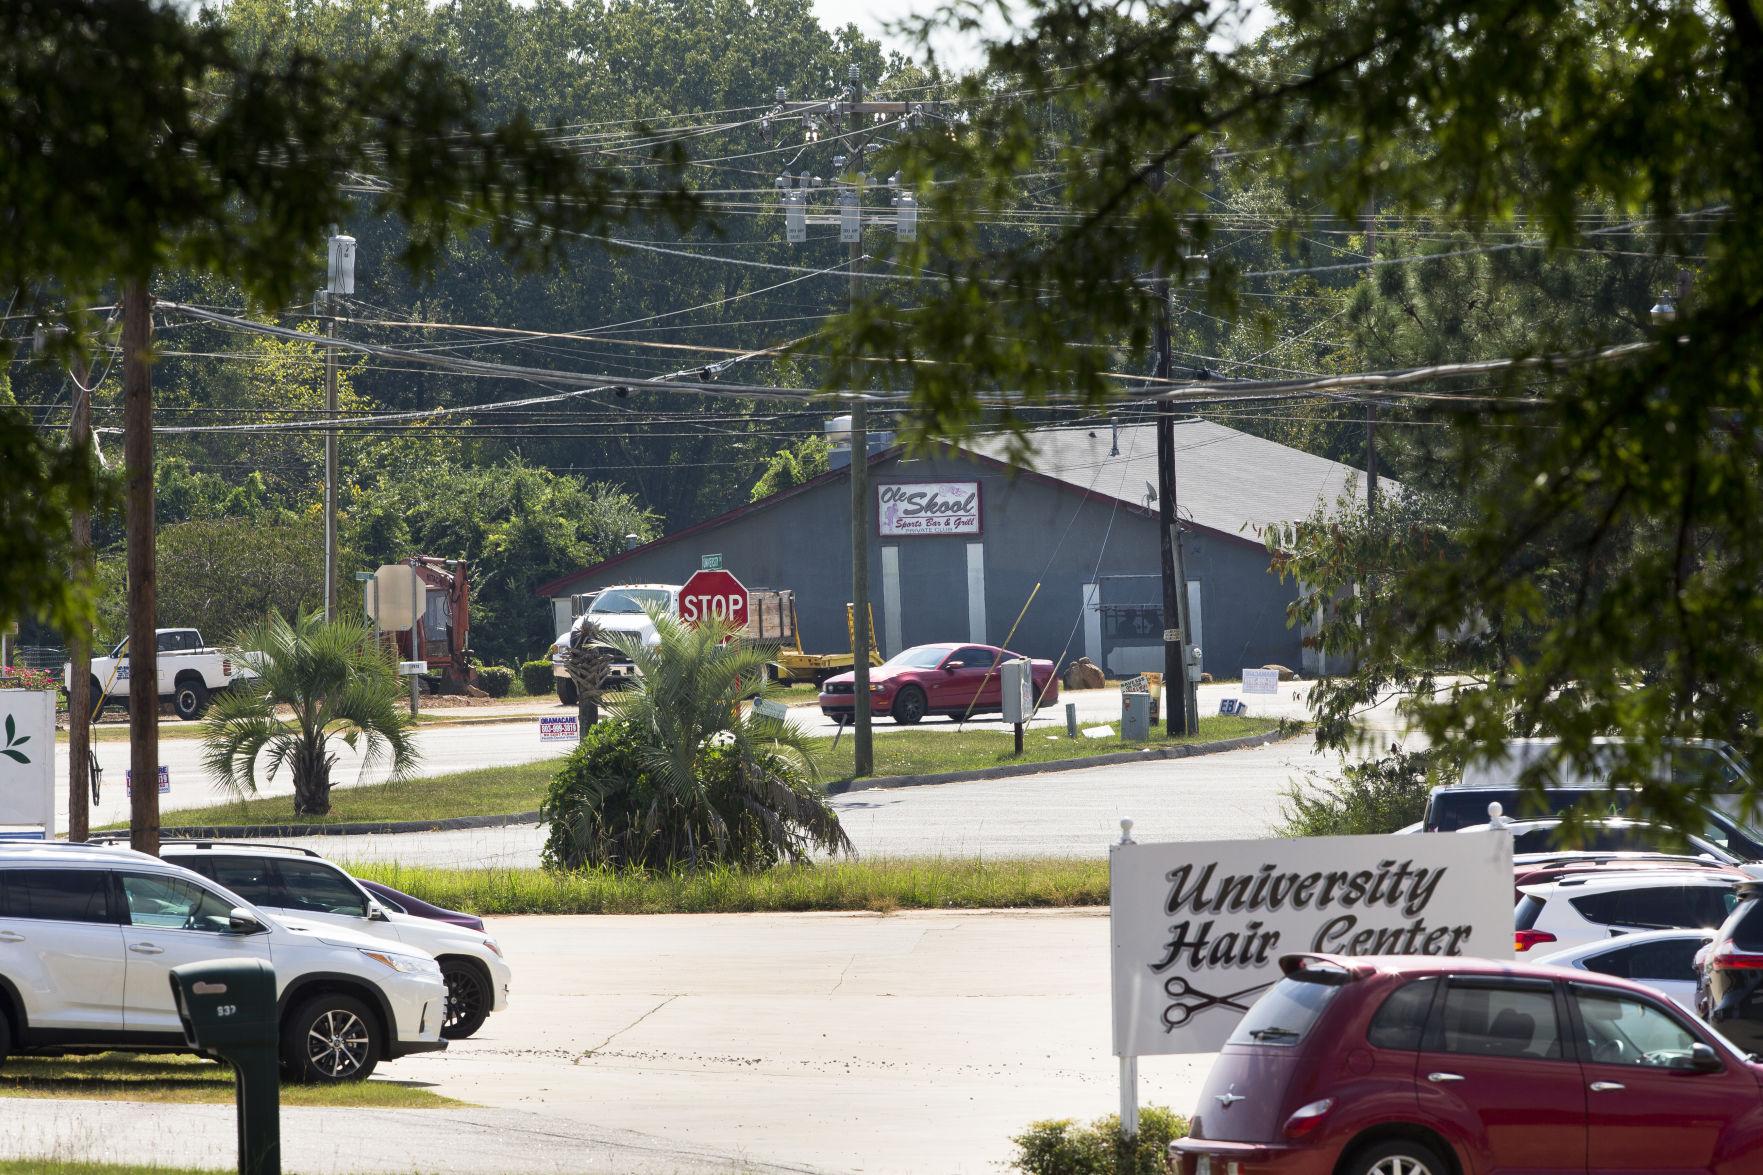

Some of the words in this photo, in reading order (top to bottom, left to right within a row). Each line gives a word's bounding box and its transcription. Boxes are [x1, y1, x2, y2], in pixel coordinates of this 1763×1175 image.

[880, 486, 908, 504] Ole
[902, 492, 976, 516] Skool
[895, 519, 922, 530] Sports
[925, 518, 942, 528] Bar
[943, 518, 951, 527] &
[953, 517, 975, 530] Grill
[684, 595, 743, 622] STOP
[1163, 859, 1449, 918] University
[1147, 920, 1282, 975] Hair
[1311, 914, 1474, 956] Center
